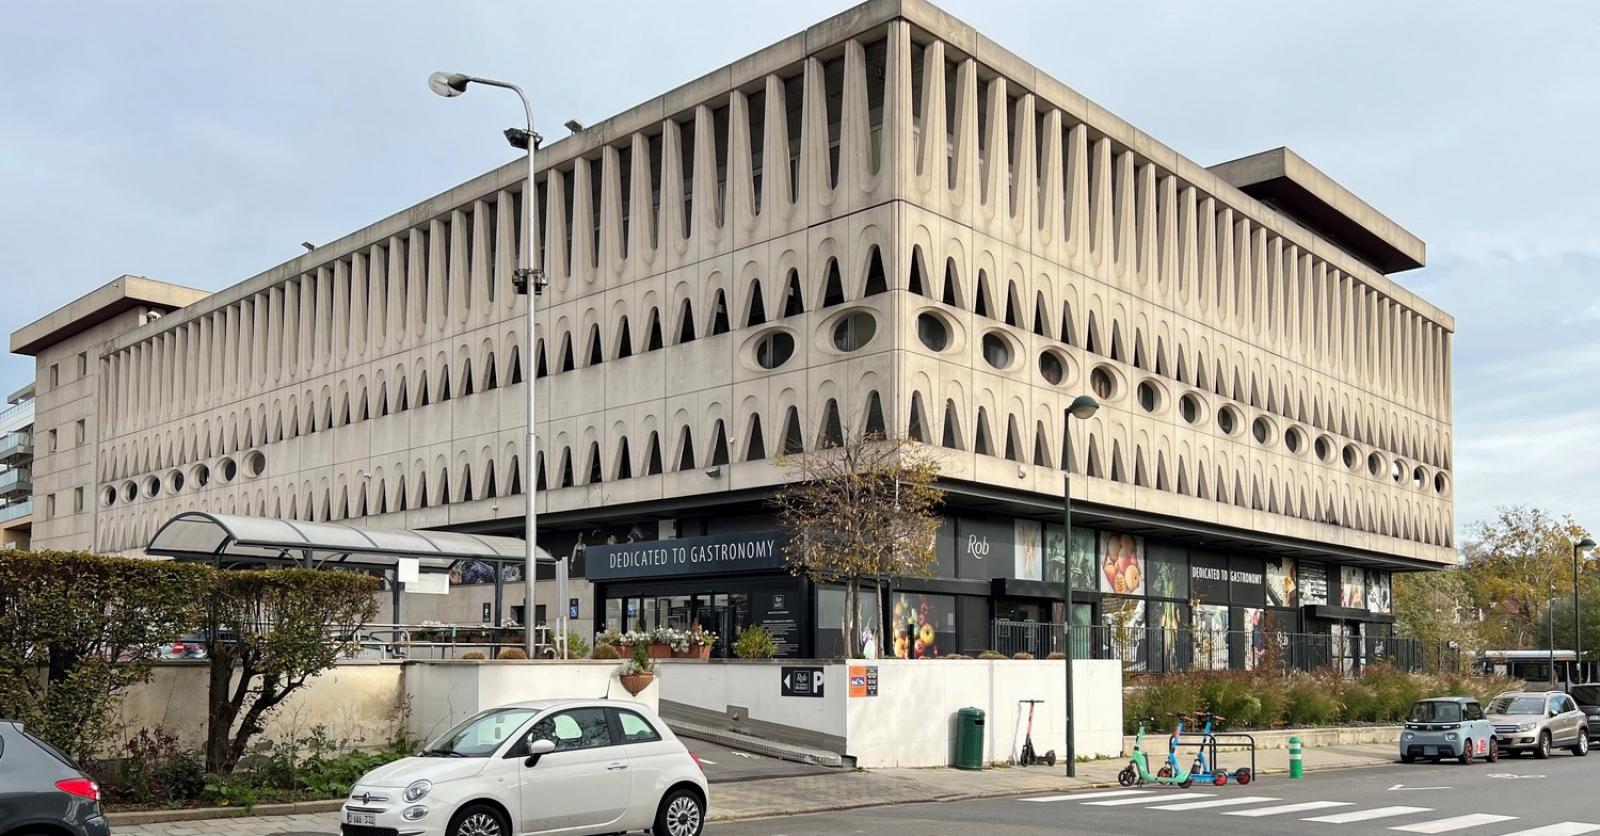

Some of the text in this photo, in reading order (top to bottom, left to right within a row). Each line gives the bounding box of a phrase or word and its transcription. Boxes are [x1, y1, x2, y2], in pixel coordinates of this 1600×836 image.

[609, 540, 774, 569] DEDICATED TO GASTRONOMY
[967, 534, 990, 560] Rob
[1192, 566, 1262, 585] DEDICATED TO GASTRONOMY
[813, 671, 824, 694] P
